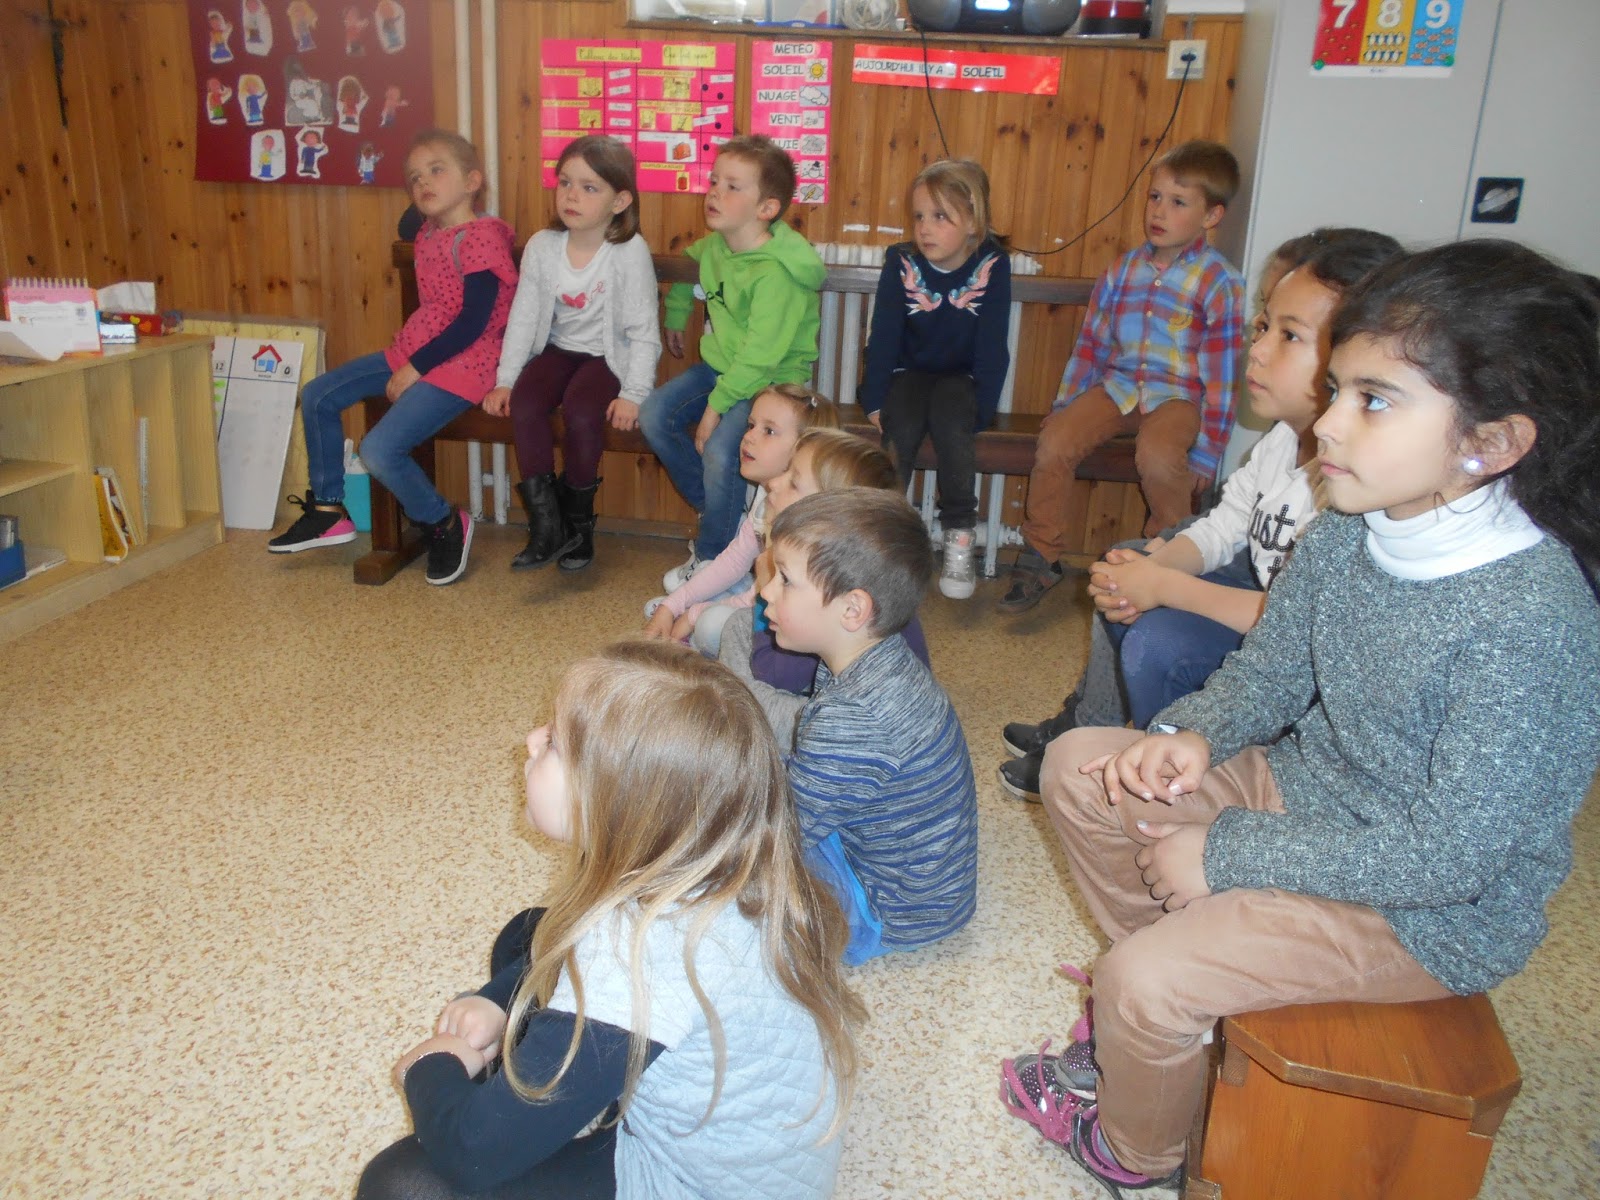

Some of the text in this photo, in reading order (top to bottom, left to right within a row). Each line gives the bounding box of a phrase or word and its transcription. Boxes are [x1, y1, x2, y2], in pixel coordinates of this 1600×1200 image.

[1332, 0, 1450, 28] 7 8 9
[763, 64, 804, 75] SOLEIL
[962, 66, 1003, 77] SOLEIL
[758, 91, 797, 101] NUAGE
[770, 114, 800, 125] VENT
